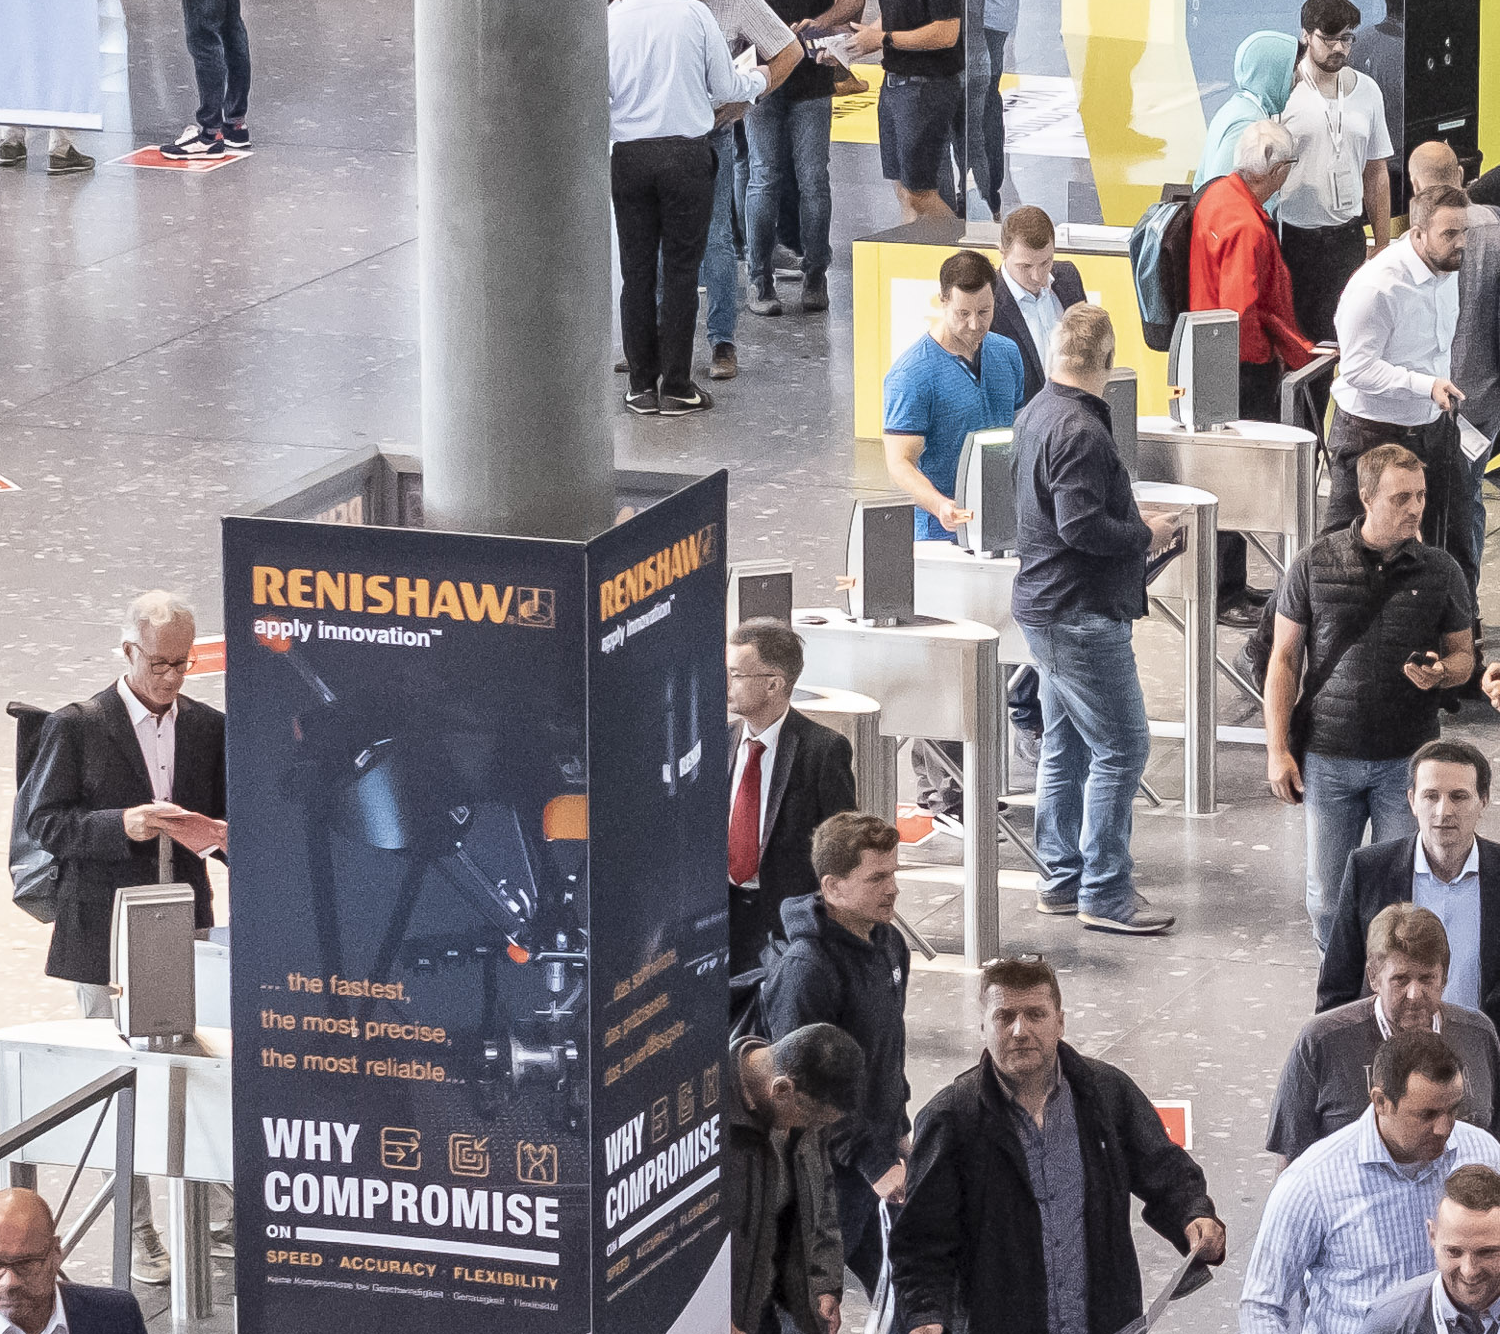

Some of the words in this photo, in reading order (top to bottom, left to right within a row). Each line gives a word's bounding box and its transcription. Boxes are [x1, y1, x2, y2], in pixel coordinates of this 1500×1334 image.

[252, 565, 514, 625] RENISHAW
[600, 533, 702, 621] RENISHAW
[253, 618, 312, 642] apply
[287, 973, 324, 995] the
[329, 974, 412, 1004] fastest,
[261, 1009, 296, 1031] the
[302, 1016, 359, 1037] most
[364, 1020, 453, 1047] precise,
[261, 1048, 297, 1069] the
[303, 1053, 359, 1074] most
[262, 1116, 361, 1164] WHY
[605, 1112, 645, 1176] WHY
[605, 1113, 721, 1230] COMPROMISE
[264, 1171, 560, 1239] COMPROMISE
[266, 1225, 291, 1240] ON
[266, 1250, 323, 1268] SPEED
[339, 1255, 437, 1278] ACCURACY
[453, 1266, 559, 1291] FLEXIBILITY
